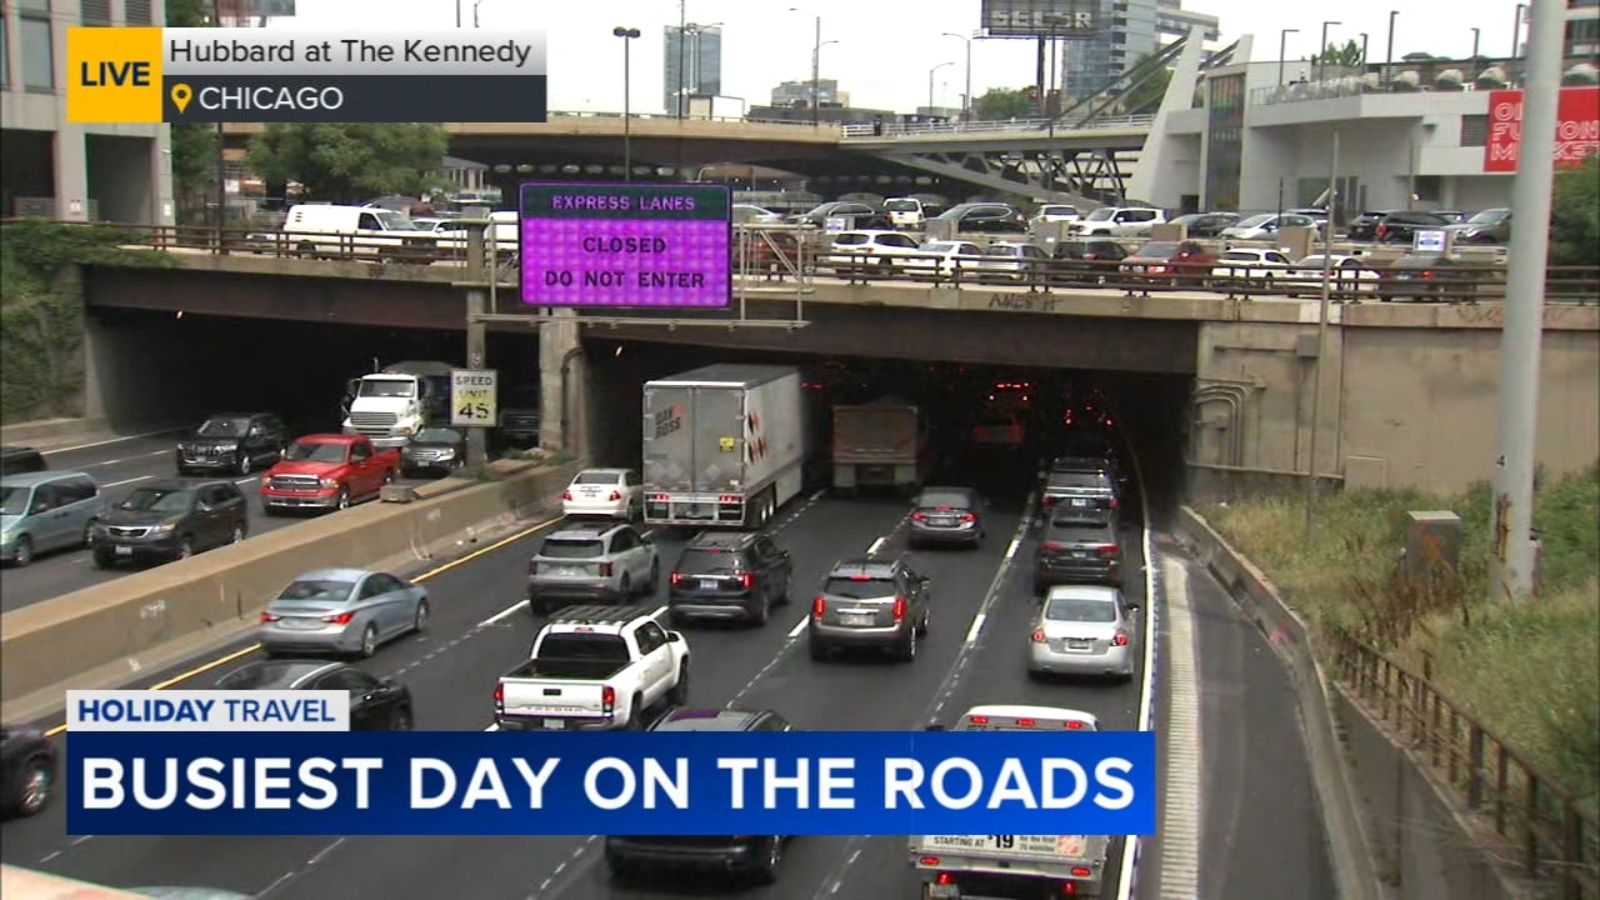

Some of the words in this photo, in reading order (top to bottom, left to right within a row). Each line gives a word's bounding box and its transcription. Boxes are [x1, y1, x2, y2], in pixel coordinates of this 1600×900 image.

[553, 195, 630, 210] EXPRESS
[640, 197, 695, 210] LANES
[583, 237, 666, 253] CLOSED
[545, 270, 573, 286] DO
[584, 271, 625, 287] NOT
[638, 272, 705, 288] ENTER
[455, 376, 493, 386] SPEED
[459, 402, 490, 419] 45
[934, 836, 973, 846] STARTING
[975, 839, 985, 847] AT
